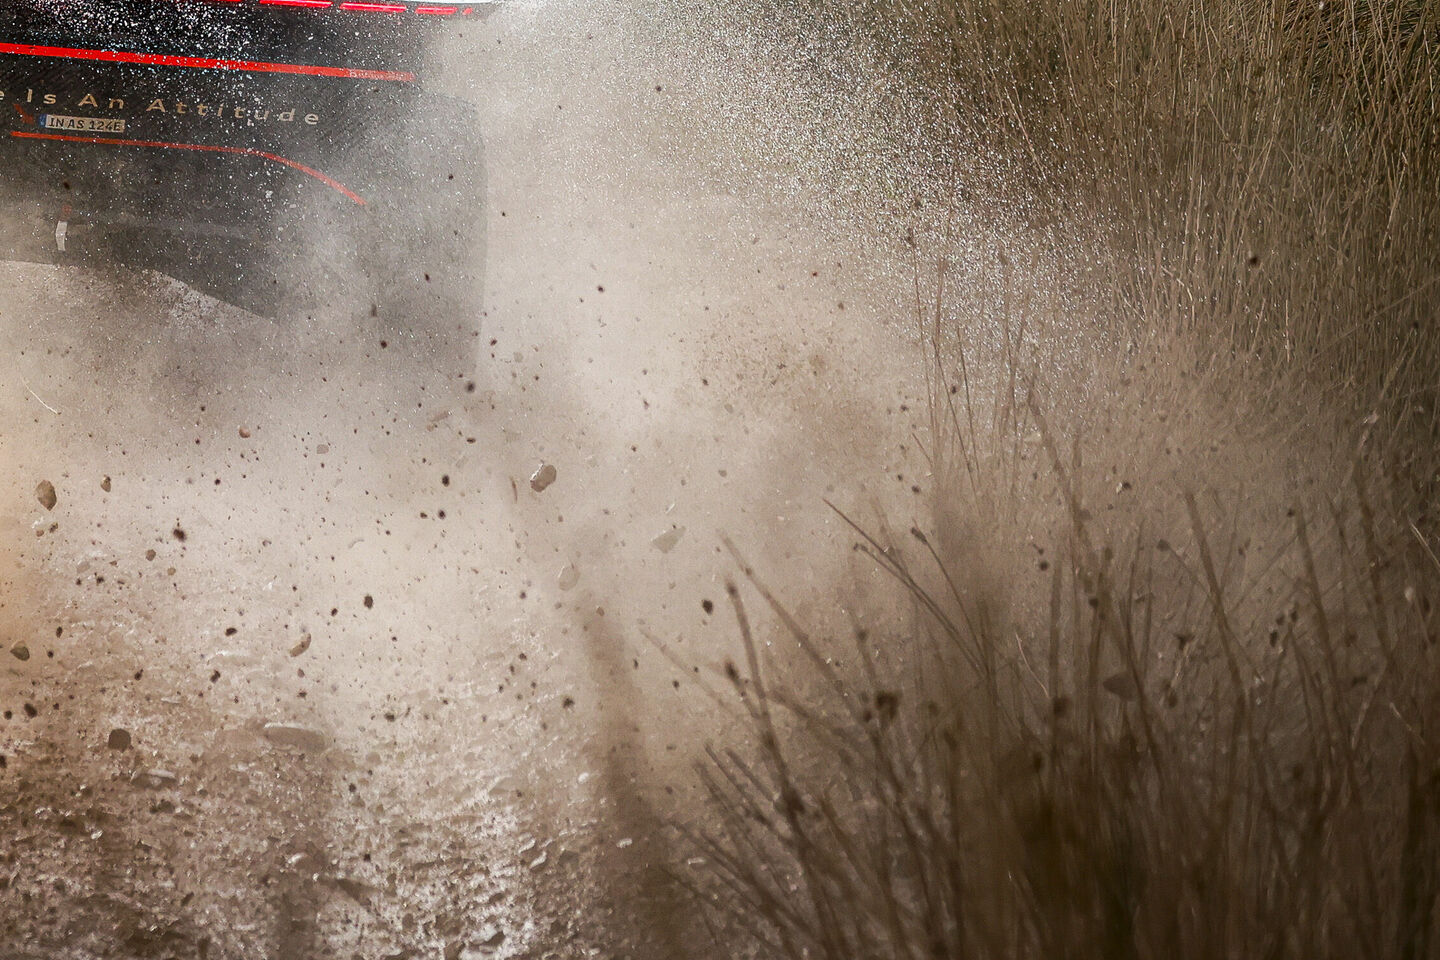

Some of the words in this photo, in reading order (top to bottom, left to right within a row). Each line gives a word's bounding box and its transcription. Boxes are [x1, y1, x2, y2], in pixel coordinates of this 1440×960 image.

[26, 88, 57, 105] Is
[77, 93, 125, 109] An
[145, 98, 320, 126] Attitude
[49, 117, 65, 127] IN
[67, 119, 85, 129] AS
